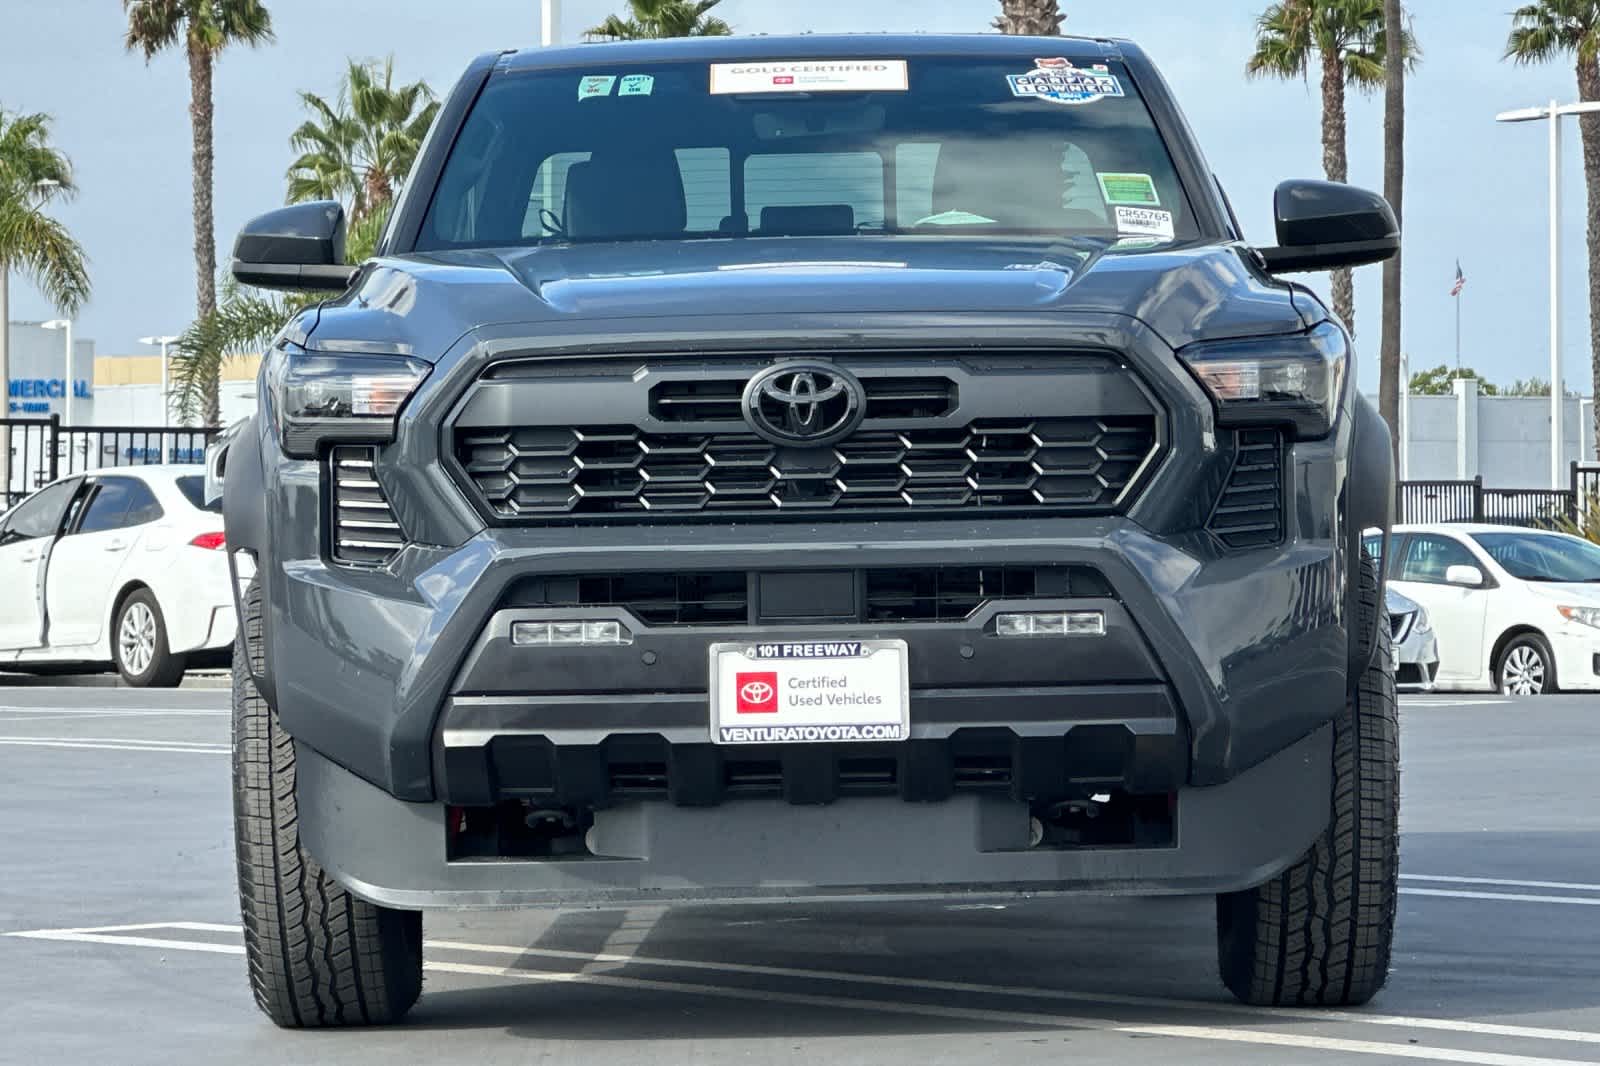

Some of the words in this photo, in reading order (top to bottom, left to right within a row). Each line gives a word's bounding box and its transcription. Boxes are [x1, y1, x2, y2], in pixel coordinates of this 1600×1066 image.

[730, 66, 786, 74] GOLD
[790, 64, 888, 73] CERTIFIED
[1016, 77, 1115, 85] CARFAX
[1036, 85, 1114, 93] OWNER
[1118, 209, 1169, 222] CR55765
[758, 645, 779, 657] 101
[783, 643, 858, 657] FREEWAY
[788, 676, 847, 689] Certified
[788, 693, 823, 706] Used
[827, 692, 882, 706] Vehicles
[720, 725, 900, 742] VENTURATOYOTA.COM
